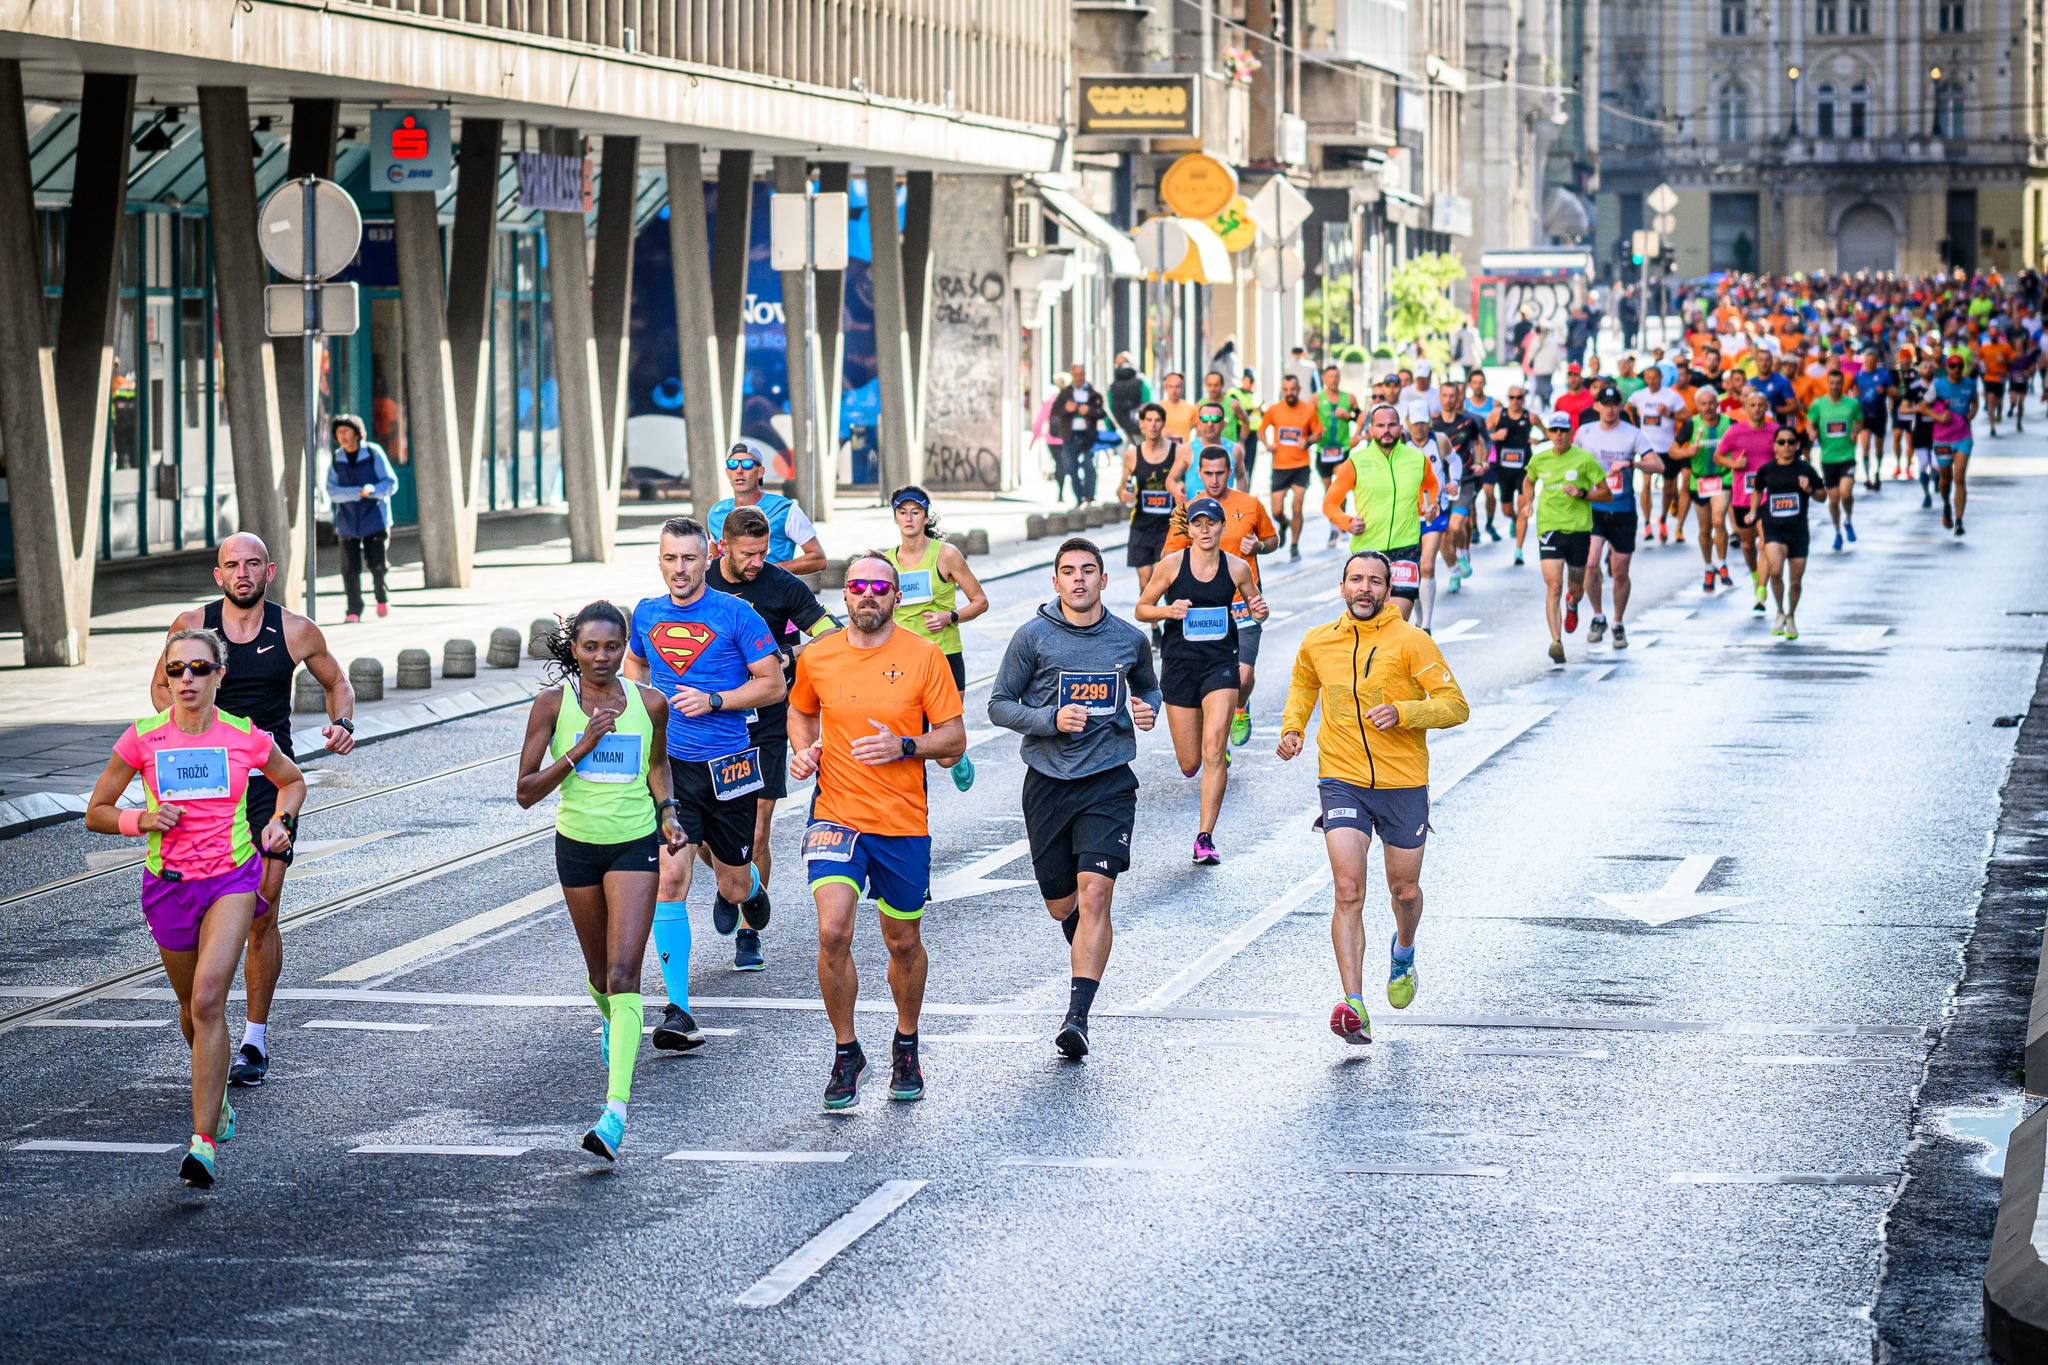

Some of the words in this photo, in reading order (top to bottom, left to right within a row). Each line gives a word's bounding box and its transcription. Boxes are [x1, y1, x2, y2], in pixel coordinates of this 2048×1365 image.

[1070, 683, 1108, 700] 2299
[592, 751, 625, 764] KIMANI
[176, 764, 209, 780] TROŽIĆ
[721, 759, 752, 784] 2729
[807, 831, 843, 847] 2190
